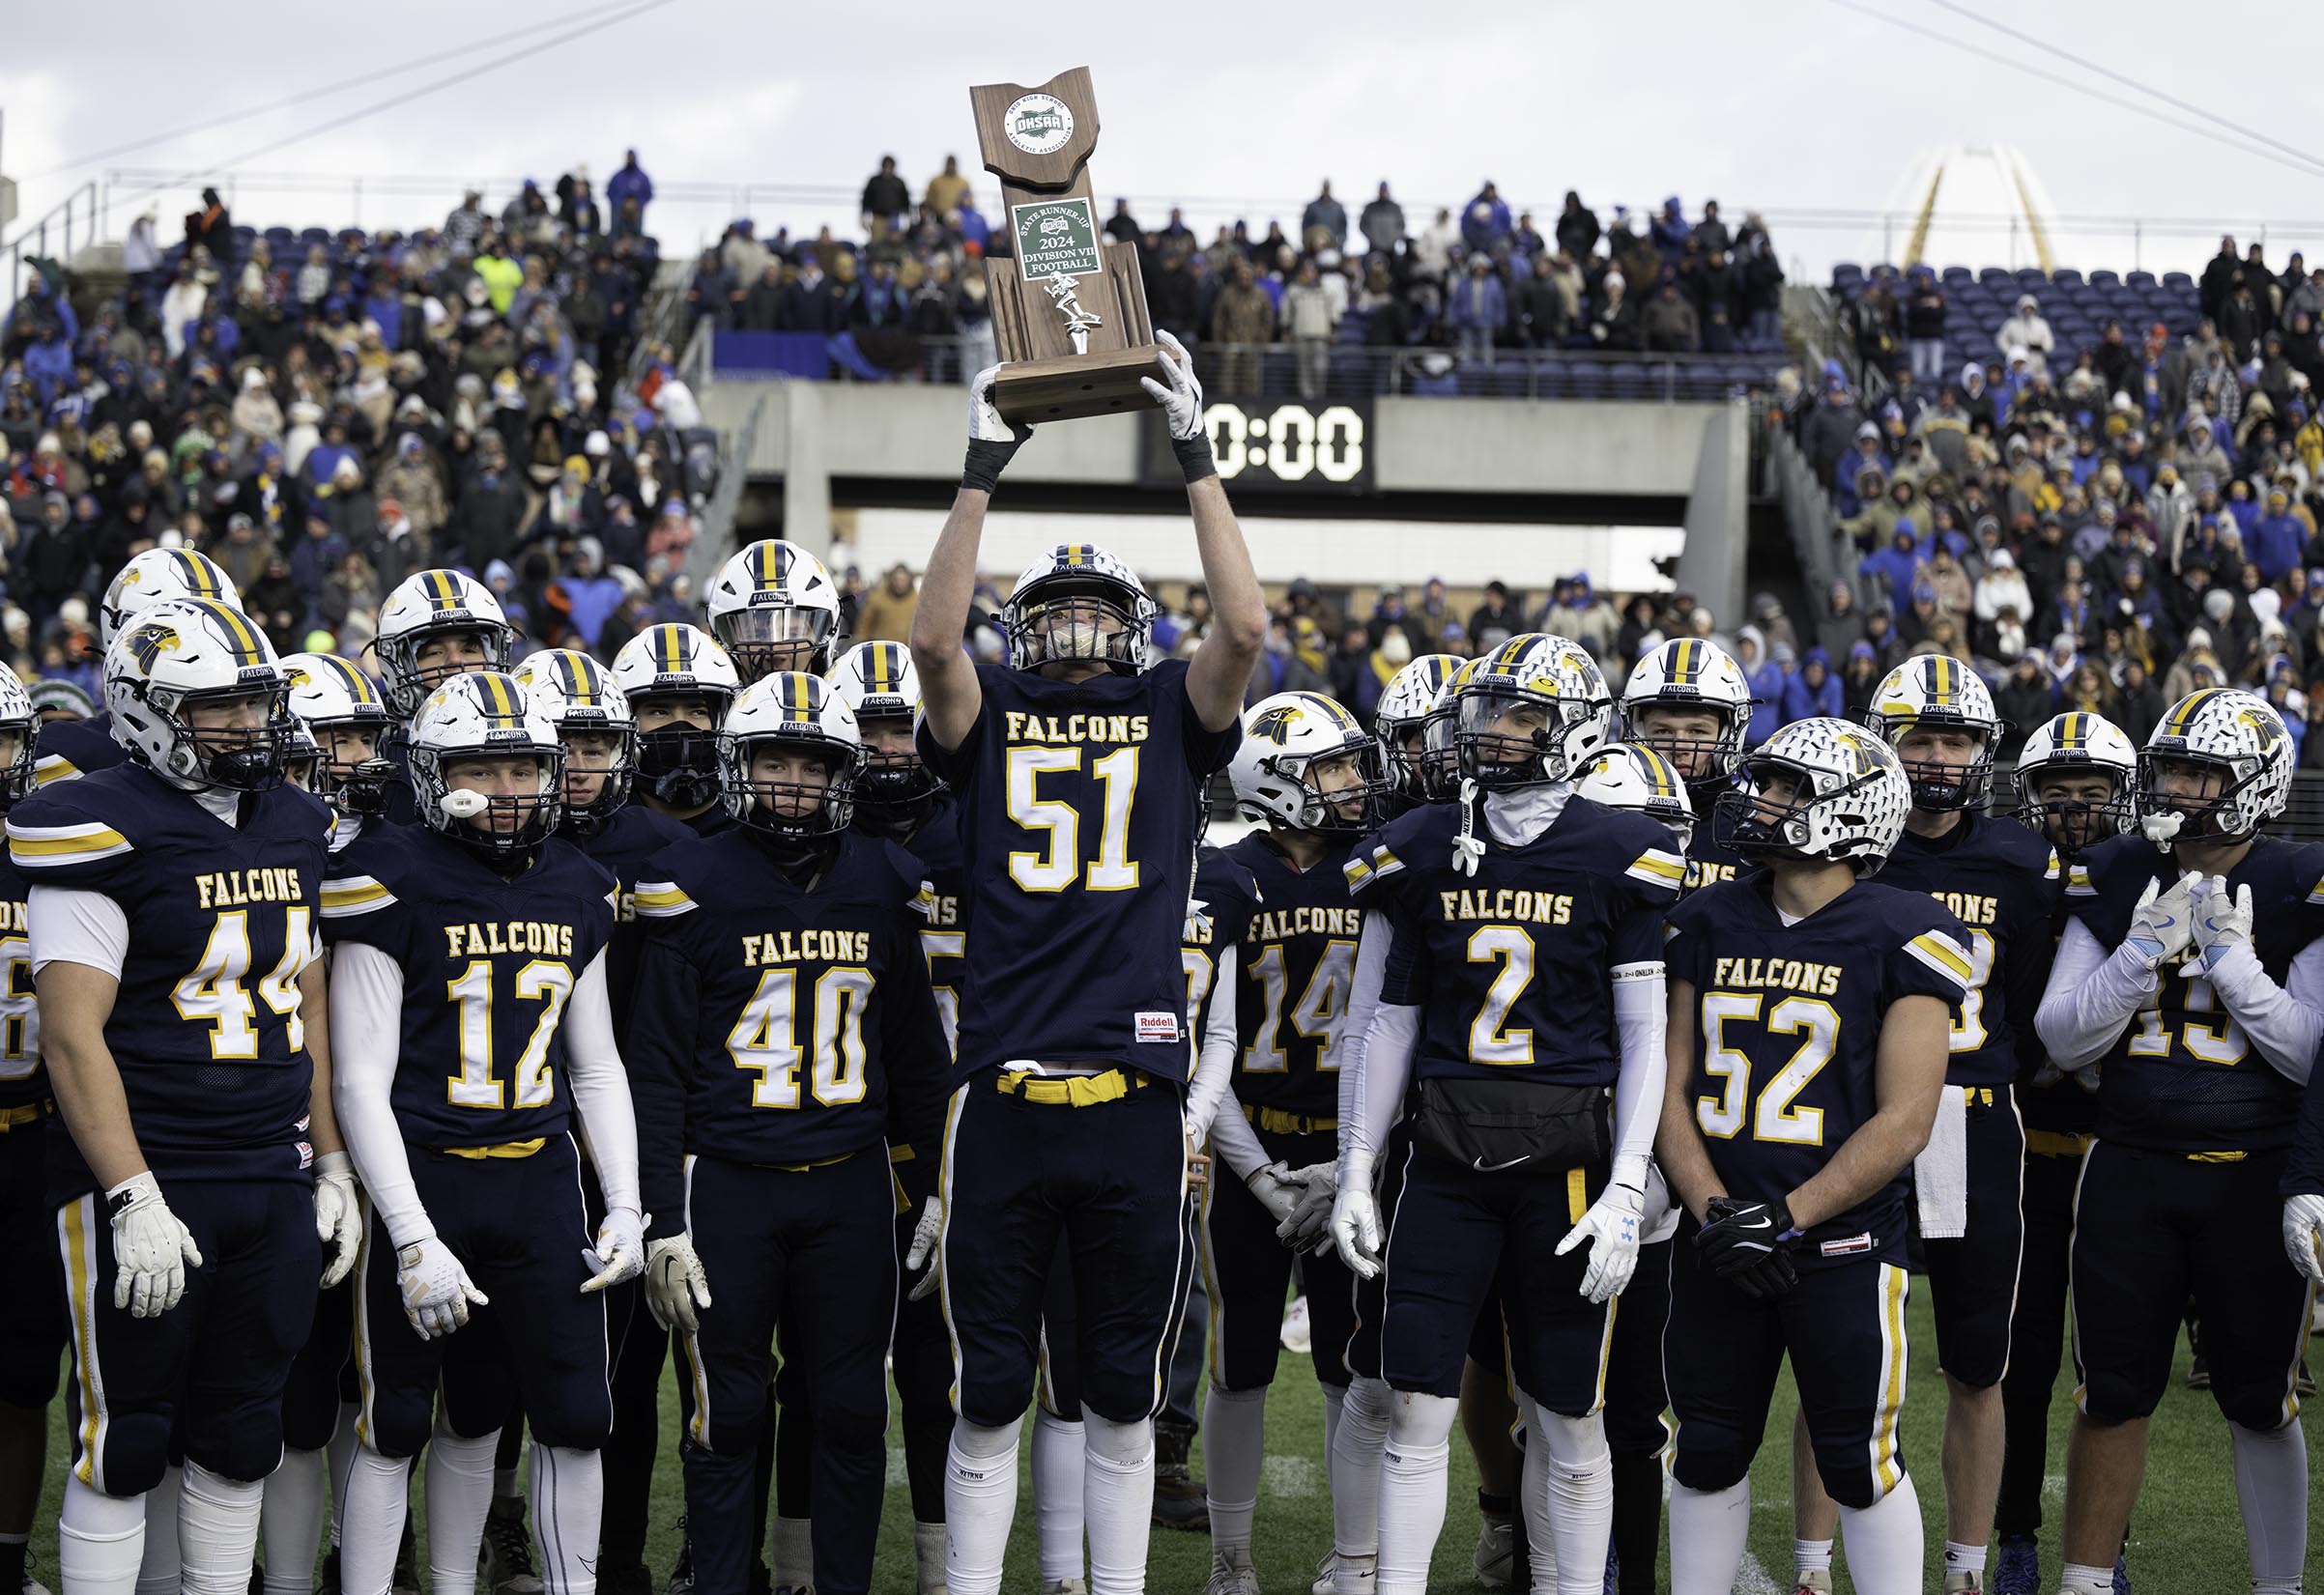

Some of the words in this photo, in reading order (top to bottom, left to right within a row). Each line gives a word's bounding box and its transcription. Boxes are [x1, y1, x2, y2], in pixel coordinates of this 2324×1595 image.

[1009, 101, 1020, 114] OHIO
[1042, 96, 1064, 109] SCHOOL
[1018, 117, 1061, 131] OHSAA
[1009, 132, 1036, 153] ATHLETIC
[1039, 127, 1072, 153] ASSOCIATION
[1020, 213, 1041, 237] STATE
[1040, 207, 1090, 229] RUNNER-UP
[1041, 220, 1068, 232] OHSAA
[1024, 249, 1076, 263] DIVISION
[1077, 247, 1095, 256] VII
[1039, 236, 1076, 249] 2024
[1032, 259, 1091, 272] FOOTBALL
[1204, 403, 1363, 482] 0:00
[754, 592, 789, 602] FALCONS
[434, 610, 469, 619] FALCONS
[241, 667, 273, 678] FALCONS
[357, 704, 383, 713] FALCONS
[488, 730, 527, 740] FALCONS
[783, 723, 819, 732] FALCONS
[1005, 711, 1149, 743] FALCONS
[1006, 745, 1140, 893] 51
[195, 868, 302, 909] FALCONS
[1440, 888, 1573, 925] FALCONS
[444, 922, 573, 957] FALCONS
[1247, 907, 1361, 944] FALCONS
[741, 929, 870, 967] FALCONS
[168, 906, 312, 1060] 44
[1714, 957, 1843, 995] FALCONS
[1242, 939, 1359, 1073] 14
[1467, 925, 1535, 1065] 2
[446, 959, 575, 1109] 12
[725, 966, 876, 1109] 40
[1140, 1017, 1174, 1027] Riddell
[1696, 992, 1841, 1147] 52
